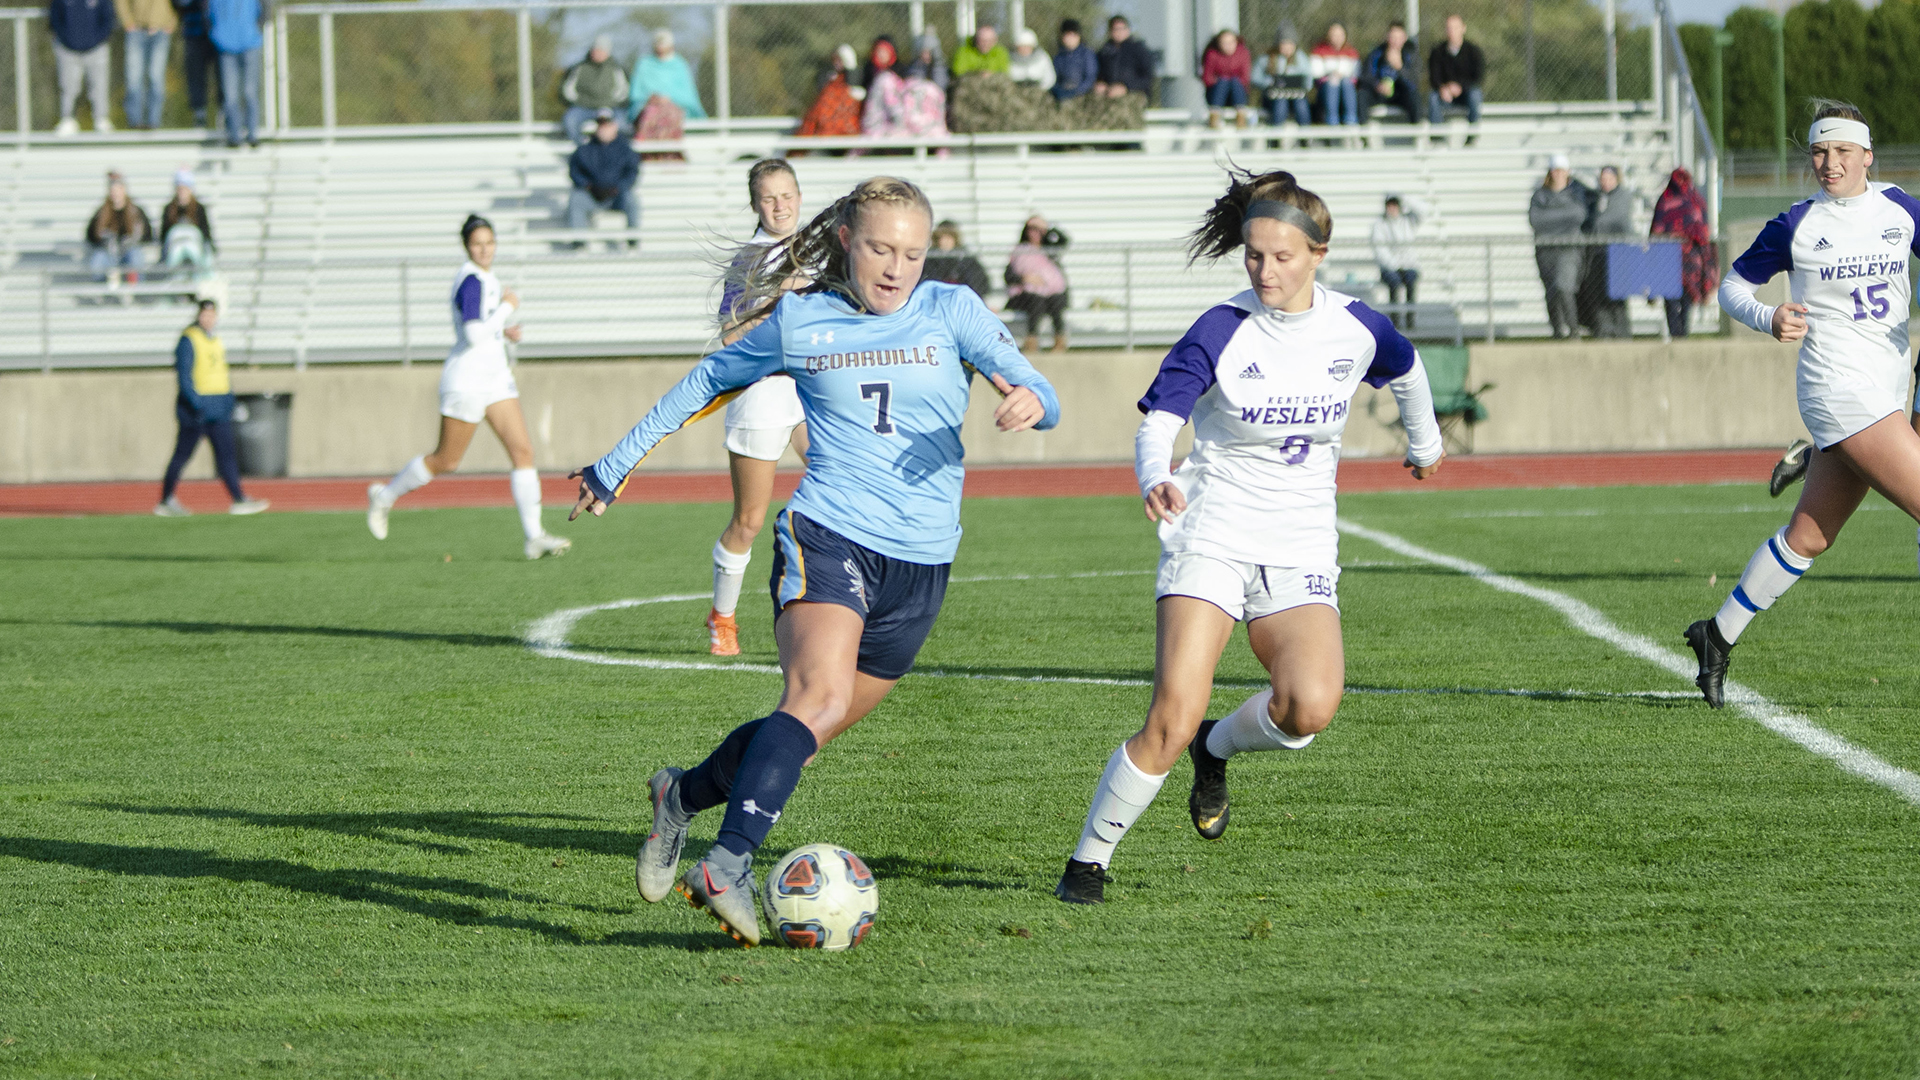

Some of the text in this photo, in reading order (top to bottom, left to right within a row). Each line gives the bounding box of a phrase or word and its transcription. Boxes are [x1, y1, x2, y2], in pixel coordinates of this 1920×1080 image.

[1819, 260, 1905, 281] WESLEYAN
[1838, 253, 1890, 264] KENTUCKY
[1849, 282, 1890, 321] 15
[805, 345, 941, 376] CEDARVILLE
[859, 381, 896, 436] 7
[1268, 394, 1333, 404] KENTUCKY
[1241, 400, 1347, 425] WESLEYAN
